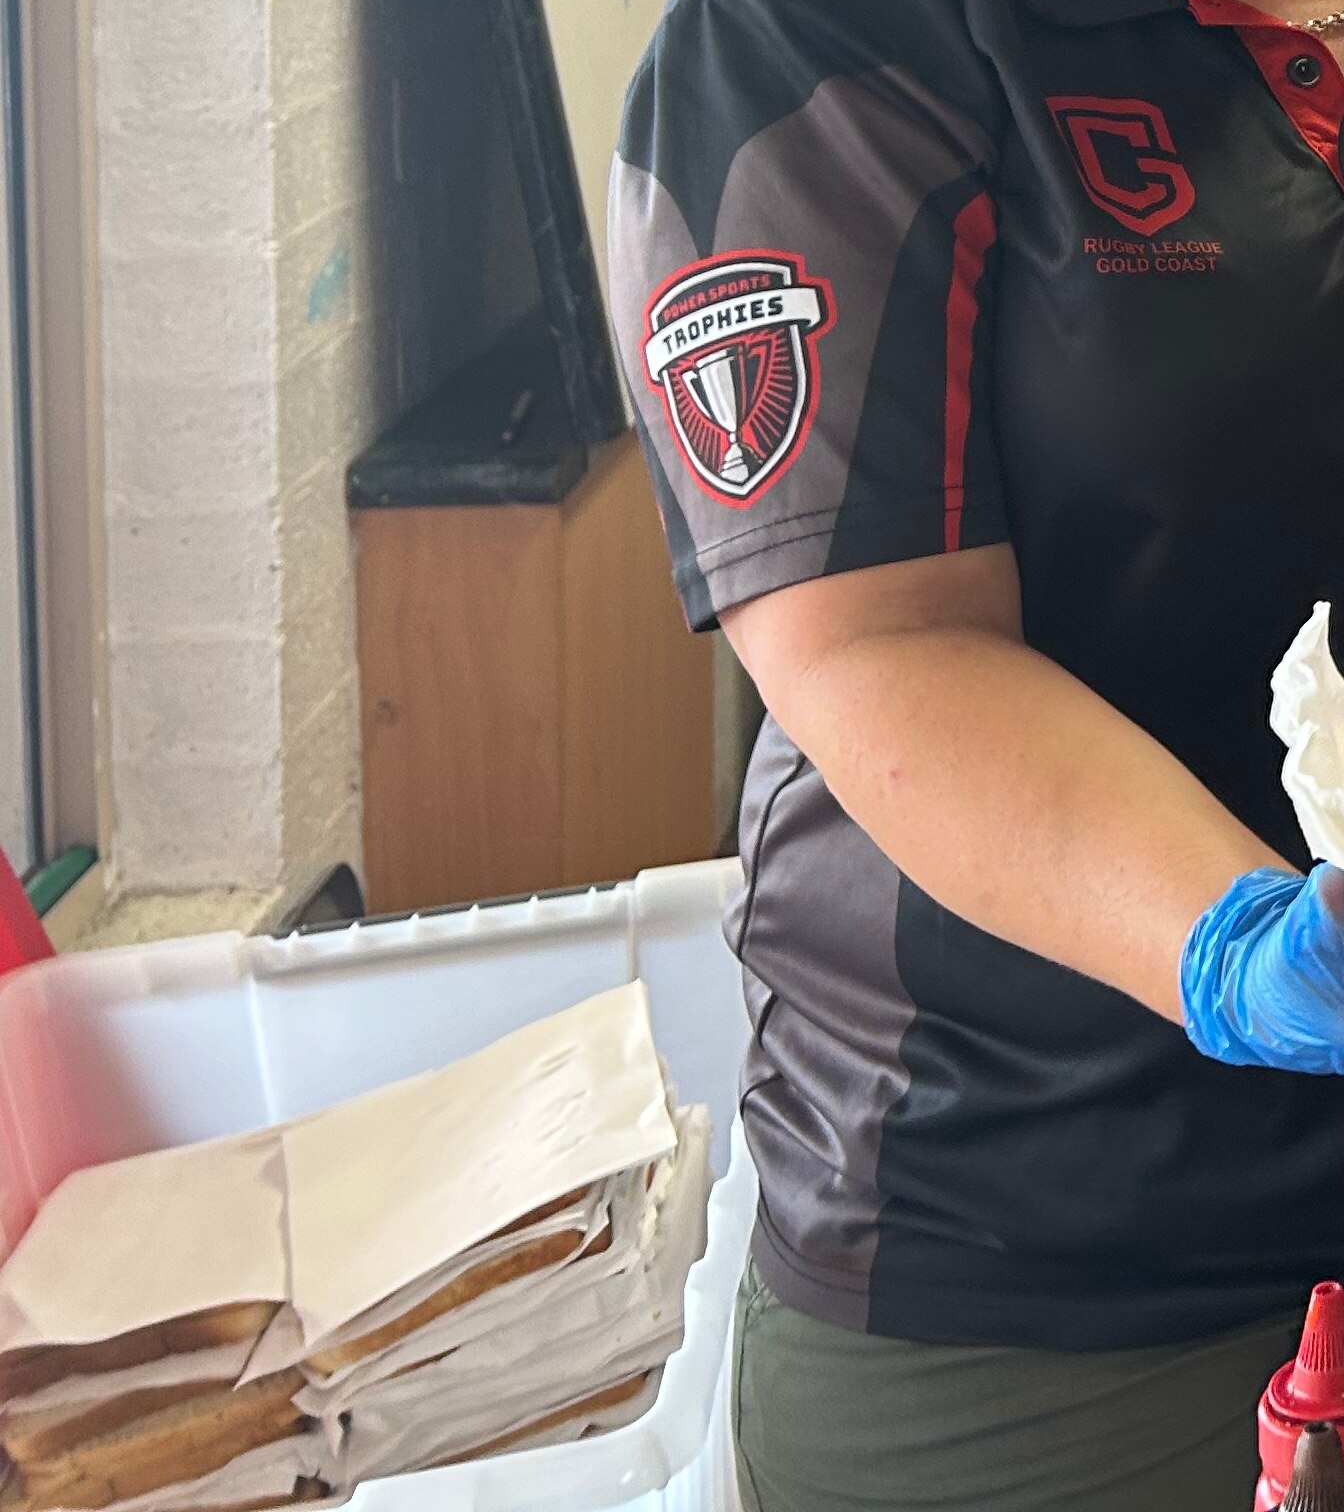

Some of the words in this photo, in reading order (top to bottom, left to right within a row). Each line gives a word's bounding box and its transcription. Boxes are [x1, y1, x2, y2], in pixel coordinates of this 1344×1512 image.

[1083, 237, 1145, 254] RUGBY
[1151, 240, 1223, 255] LEAGUE
[1096, 257, 1149, 273] GOLD
[1155, 256, 1217, 272] COAST
[662, 295, 783, 354] TROPHIES
